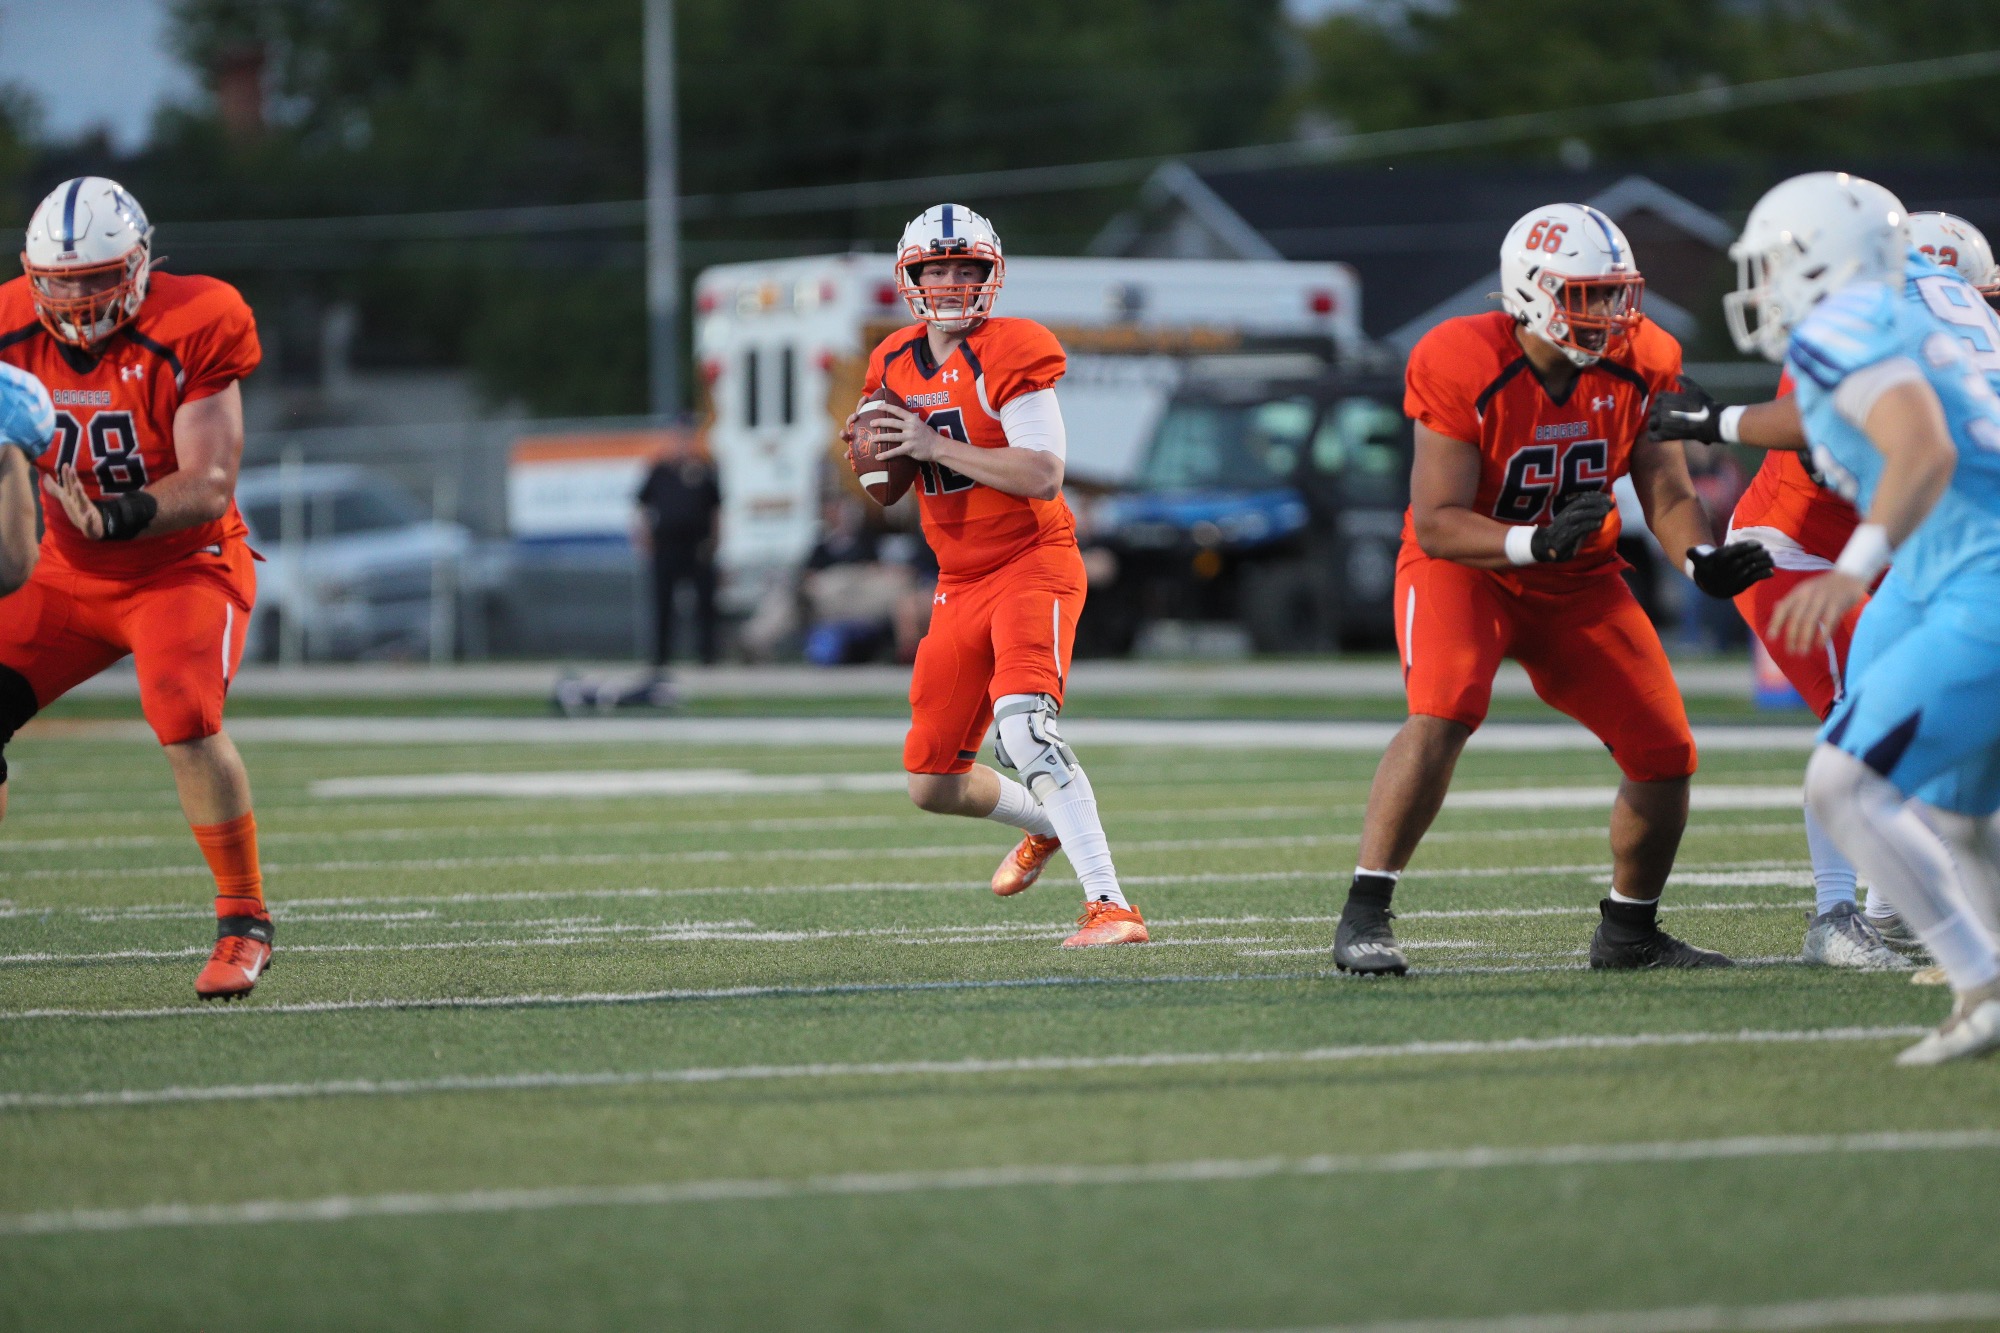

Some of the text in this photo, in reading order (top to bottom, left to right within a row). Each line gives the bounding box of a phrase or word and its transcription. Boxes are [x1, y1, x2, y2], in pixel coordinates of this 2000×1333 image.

[1526, 219, 1569, 254] 66
[53, 389, 111, 406] BADGERS
[905, 391, 949, 408] BADGERS
[1536, 421, 1588, 440] BADGERS
[54, 409, 148, 496] 78
[1491, 439, 1608, 523] 66
